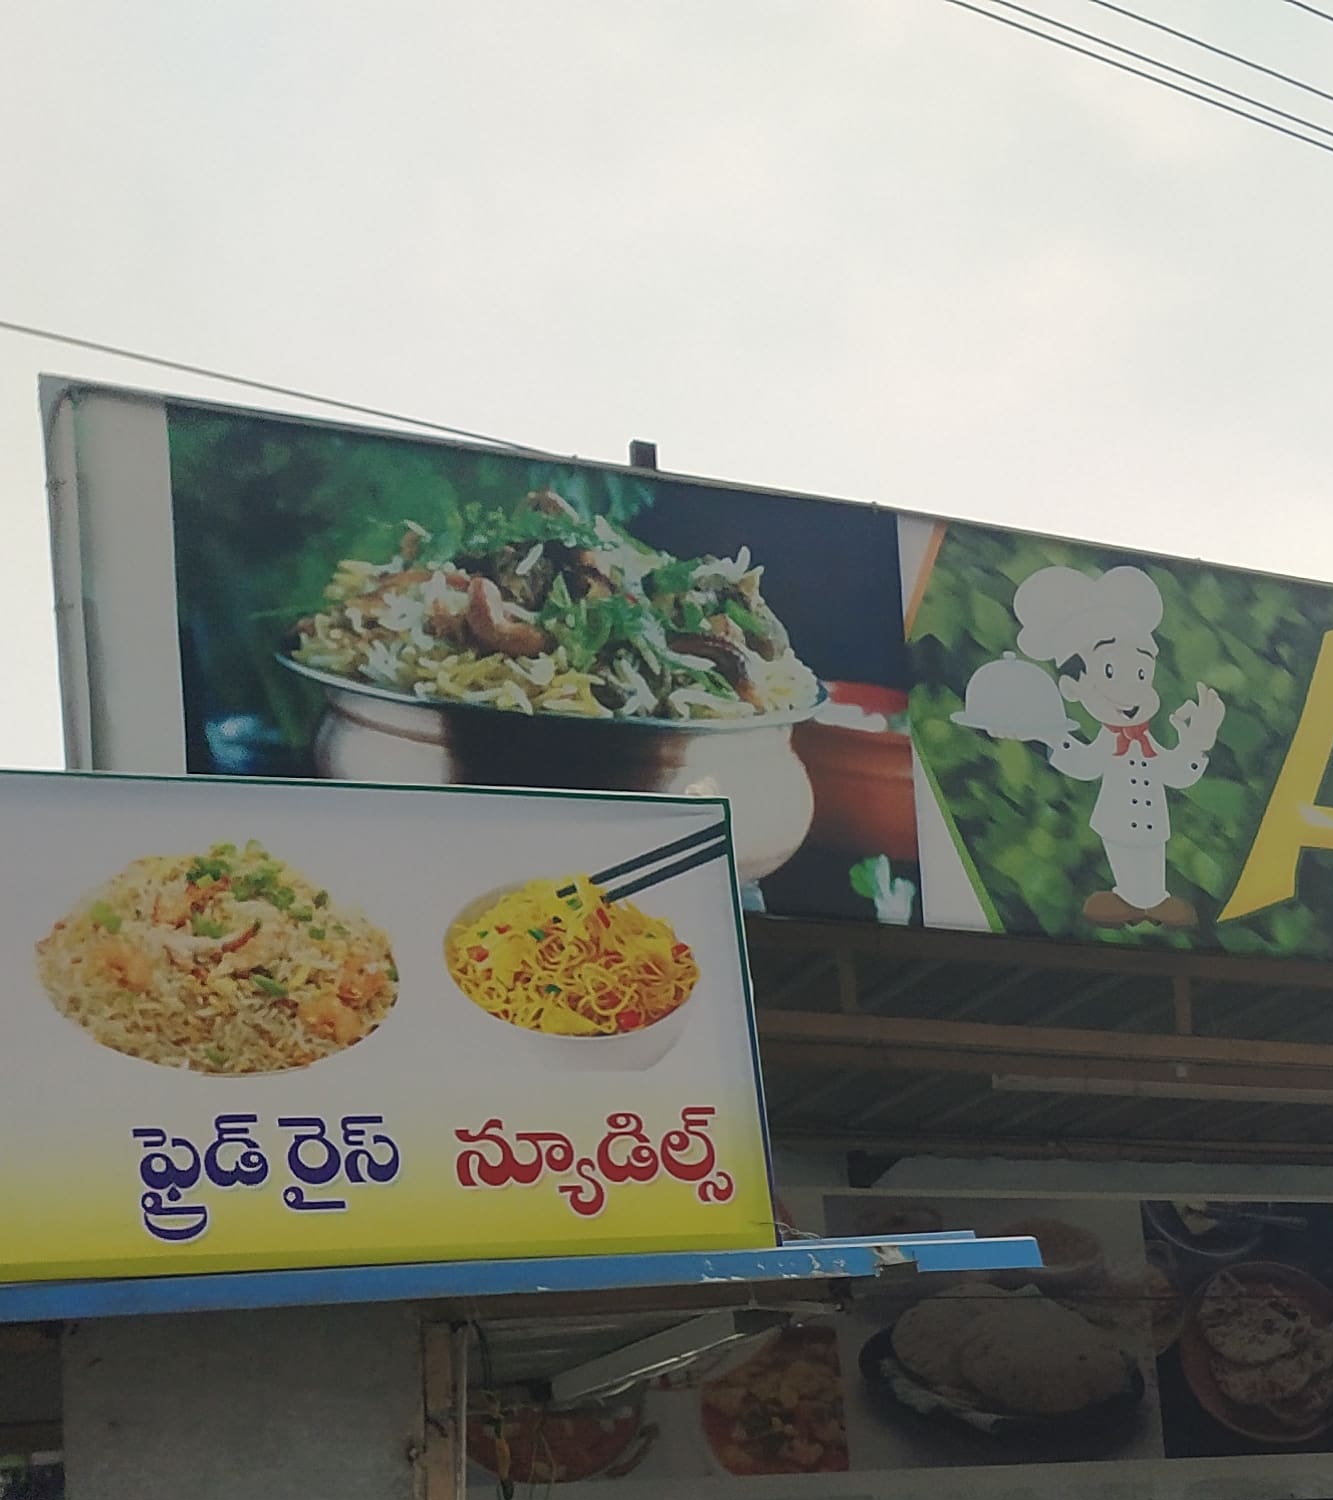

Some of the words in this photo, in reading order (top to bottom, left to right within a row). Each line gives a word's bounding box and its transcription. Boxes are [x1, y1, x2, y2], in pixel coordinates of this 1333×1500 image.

[132, 1114, 268, 1240] ఫ్రైడ్
[277, 1115, 399, 1210] రైస్
[455, 1107, 733, 1215] న్యూడిల్స్
